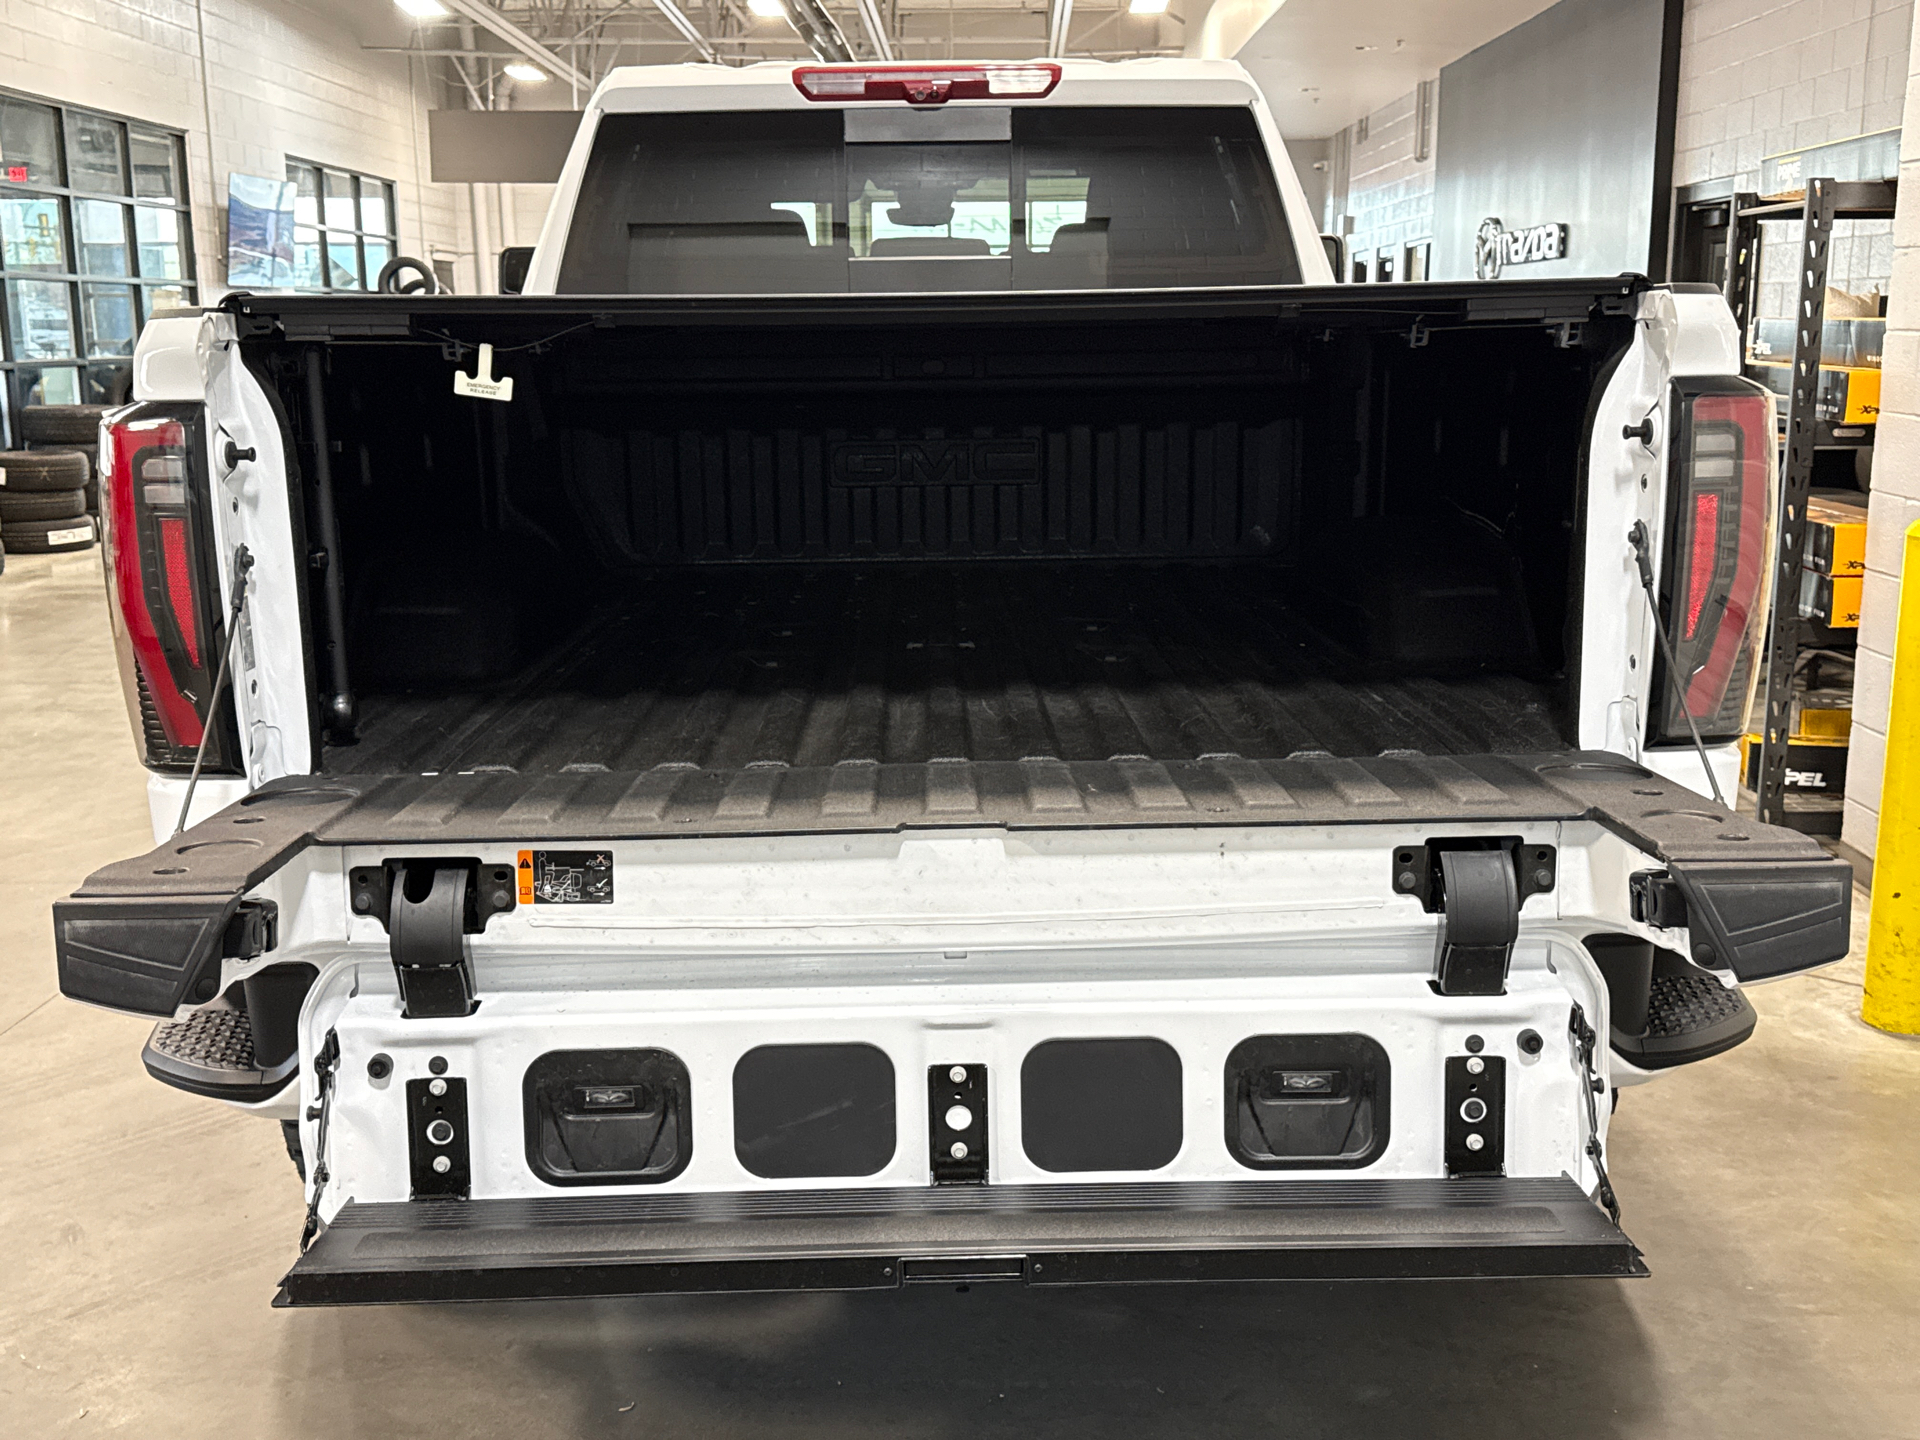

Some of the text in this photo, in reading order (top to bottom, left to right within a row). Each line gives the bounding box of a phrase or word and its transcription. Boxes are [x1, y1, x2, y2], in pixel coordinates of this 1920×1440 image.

[1495, 222, 1564, 266] mazda
[466, 382, 501, 391] EMERGENCY
[469, 388, 497, 396] RELEASE
[833, 442, 1037, 484] GMC
[1784, 767, 1827, 787] PEL
